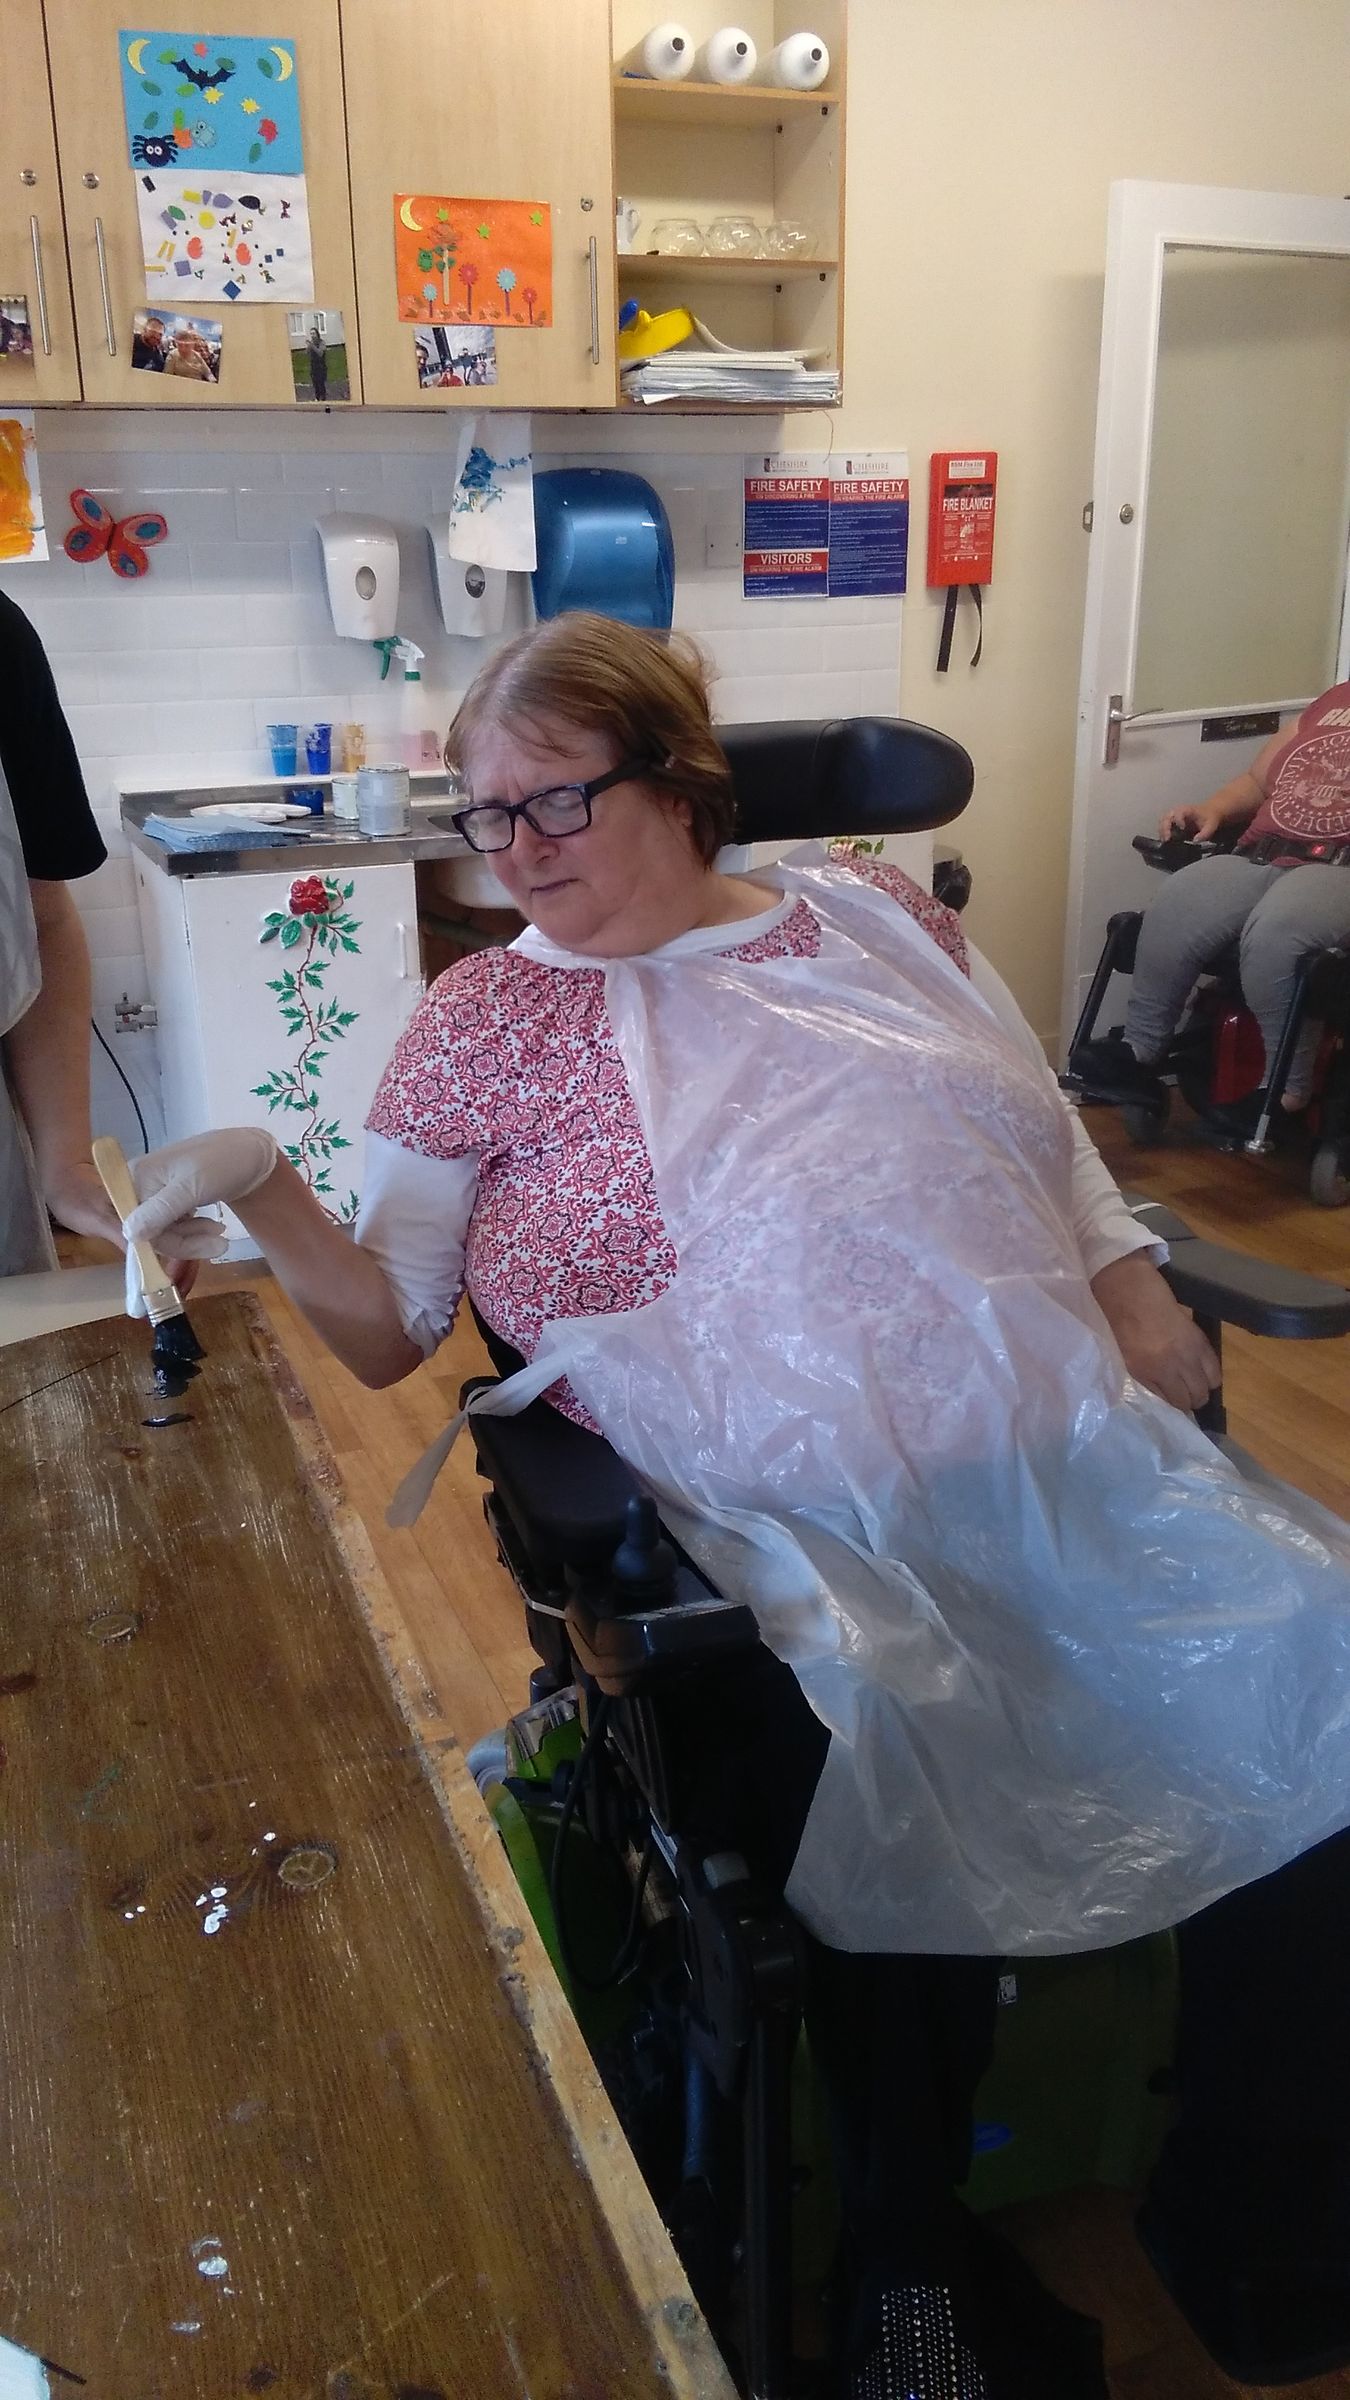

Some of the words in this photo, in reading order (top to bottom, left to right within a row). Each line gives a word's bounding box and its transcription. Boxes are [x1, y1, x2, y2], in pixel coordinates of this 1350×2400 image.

[750, 480, 776, 491] FIRE
[779, 480, 823, 491] SAFETY
[833, 482, 858, 493] FIRE
[861, 481, 904, 493] SAFETY
[943, 498, 959, 511] FIRE
[960, 497, 993, 511] BLANKET
[760, 553, 812, 564] VISITORS
